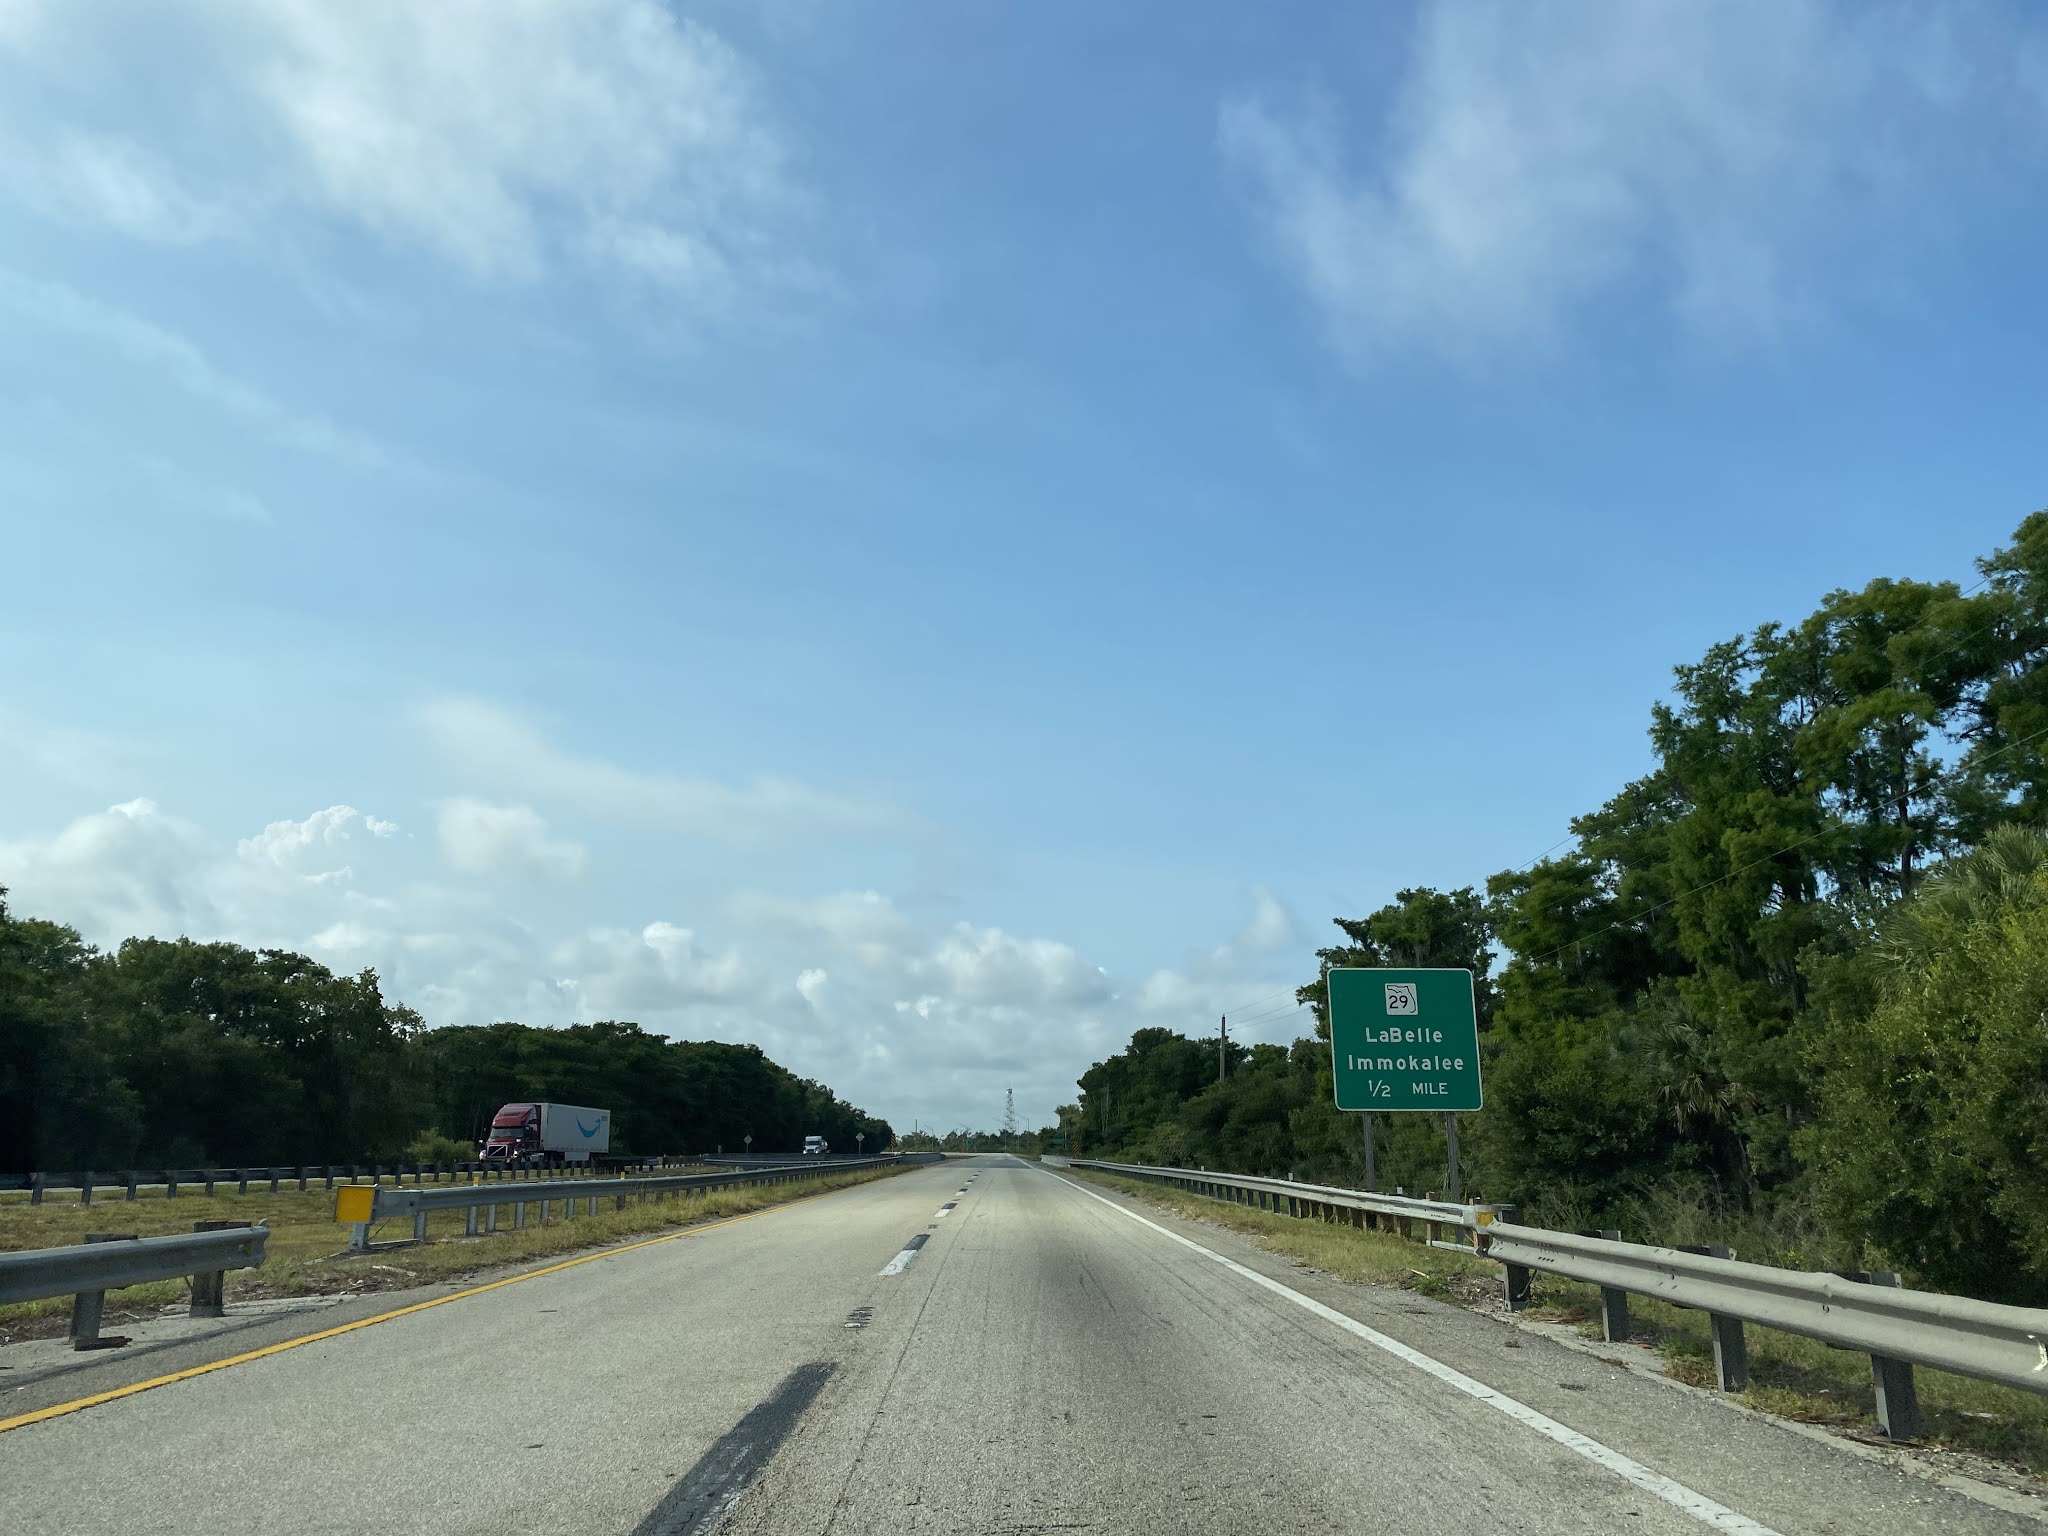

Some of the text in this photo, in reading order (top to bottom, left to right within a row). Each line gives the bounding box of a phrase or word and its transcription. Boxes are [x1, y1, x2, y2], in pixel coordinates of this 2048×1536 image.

[1389, 995, 1409, 1009] 29
[1366, 1027, 1443, 1043] LaBelle
[1348, 1055, 1464, 1071] Immokalee
[1412, 1082, 1448, 1095] MILE
